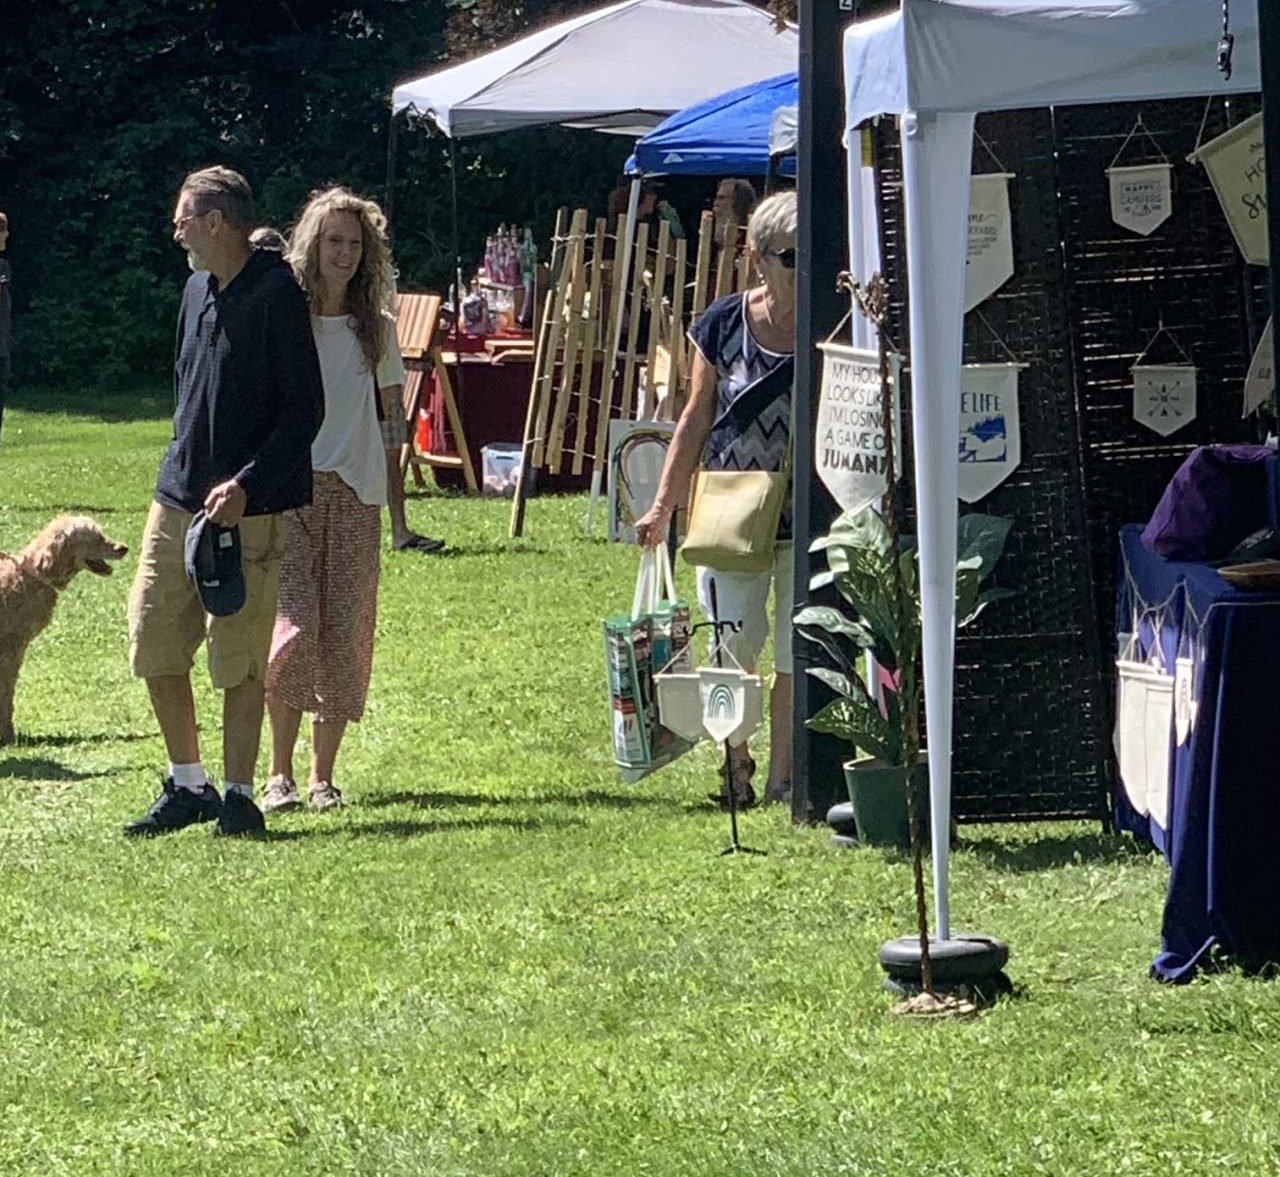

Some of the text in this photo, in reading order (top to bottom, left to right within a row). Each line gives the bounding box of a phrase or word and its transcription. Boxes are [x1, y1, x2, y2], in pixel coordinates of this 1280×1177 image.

[832, 363, 881, 384] MY HOU
[827, 384, 883, 406] LOOKS LIK
[972, 391, 1001, 413] LIFE
[824, 427, 886, 451] A GAME O
[823, 448, 887, 475] JUMANJ
